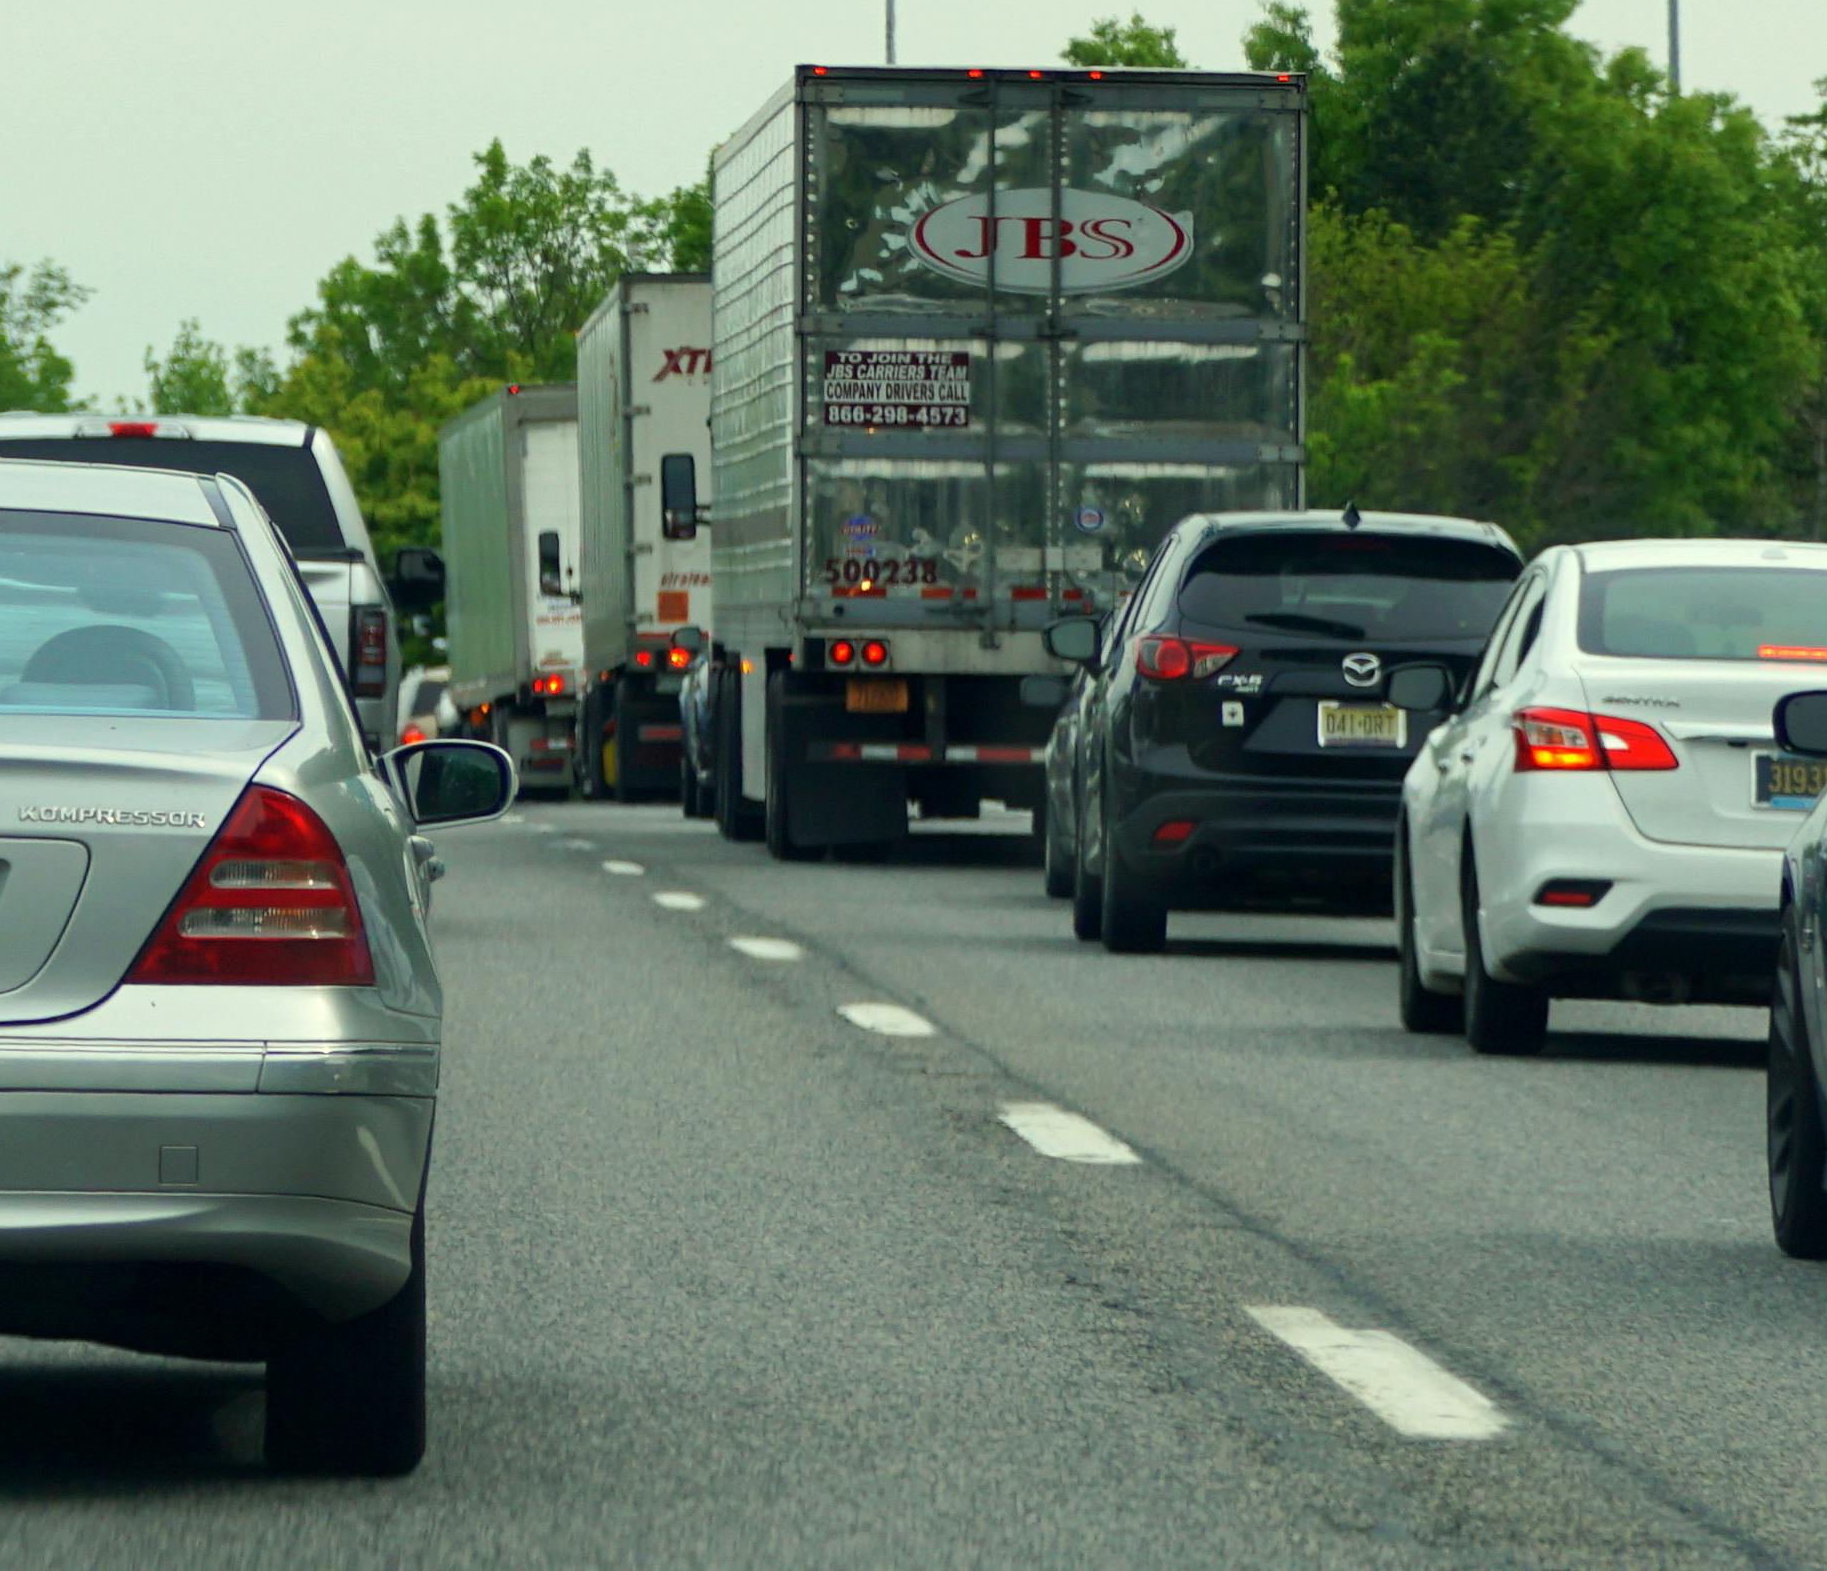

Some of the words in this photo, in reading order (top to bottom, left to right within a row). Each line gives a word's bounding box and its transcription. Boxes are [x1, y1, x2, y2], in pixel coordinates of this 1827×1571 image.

[954, 216, 1134, 259] JBS
[837, 353, 862, 364] TO
[867, 353, 911, 364] JOIN
[916, 354, 952, 364] THE
[827, 364, 853, 378] JBS
[857, 364, 924, 379] CARRIERS
[930, 365, 967, 380] TEAM
[827, 382, 882, 399] COMPANY
[886, 383, 934, 400] DRIVERS
[938, 384, 966, 401] CALL
[828, 405, 966, 424] 866-298-4573
[825, 559, 937, 584] 500238
[18, 806, 205, 828] KOMPRESSOR
